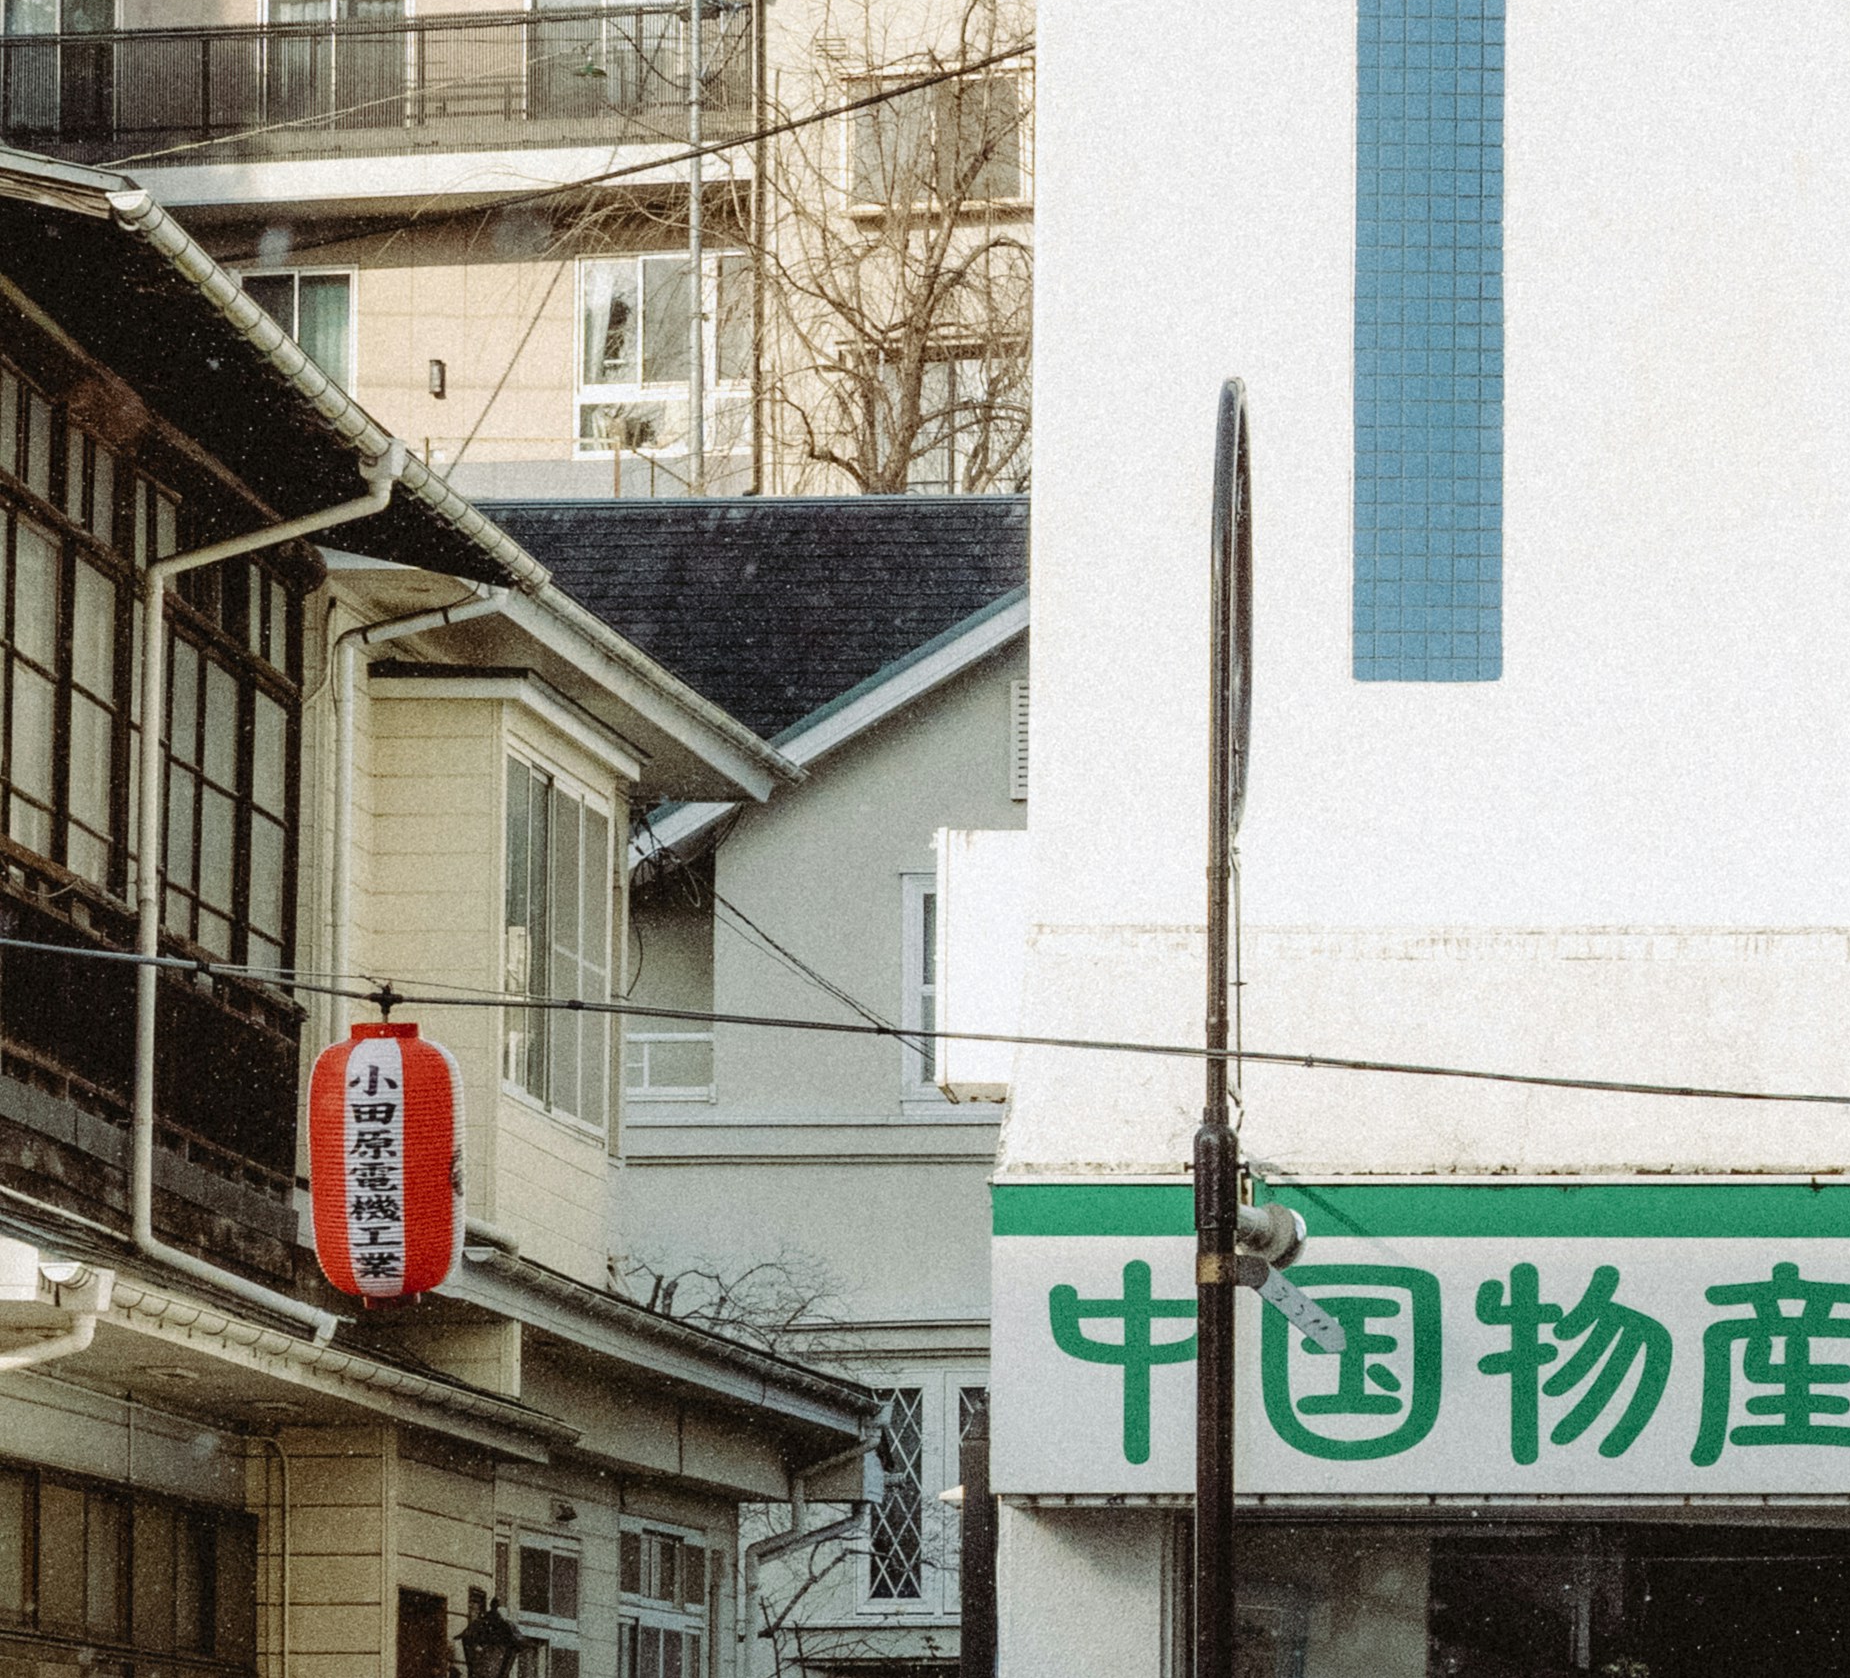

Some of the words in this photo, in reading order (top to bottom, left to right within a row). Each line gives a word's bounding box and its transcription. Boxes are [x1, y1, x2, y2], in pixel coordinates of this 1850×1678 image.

[349, 1065, 402, 1279] 小田原電機工業
